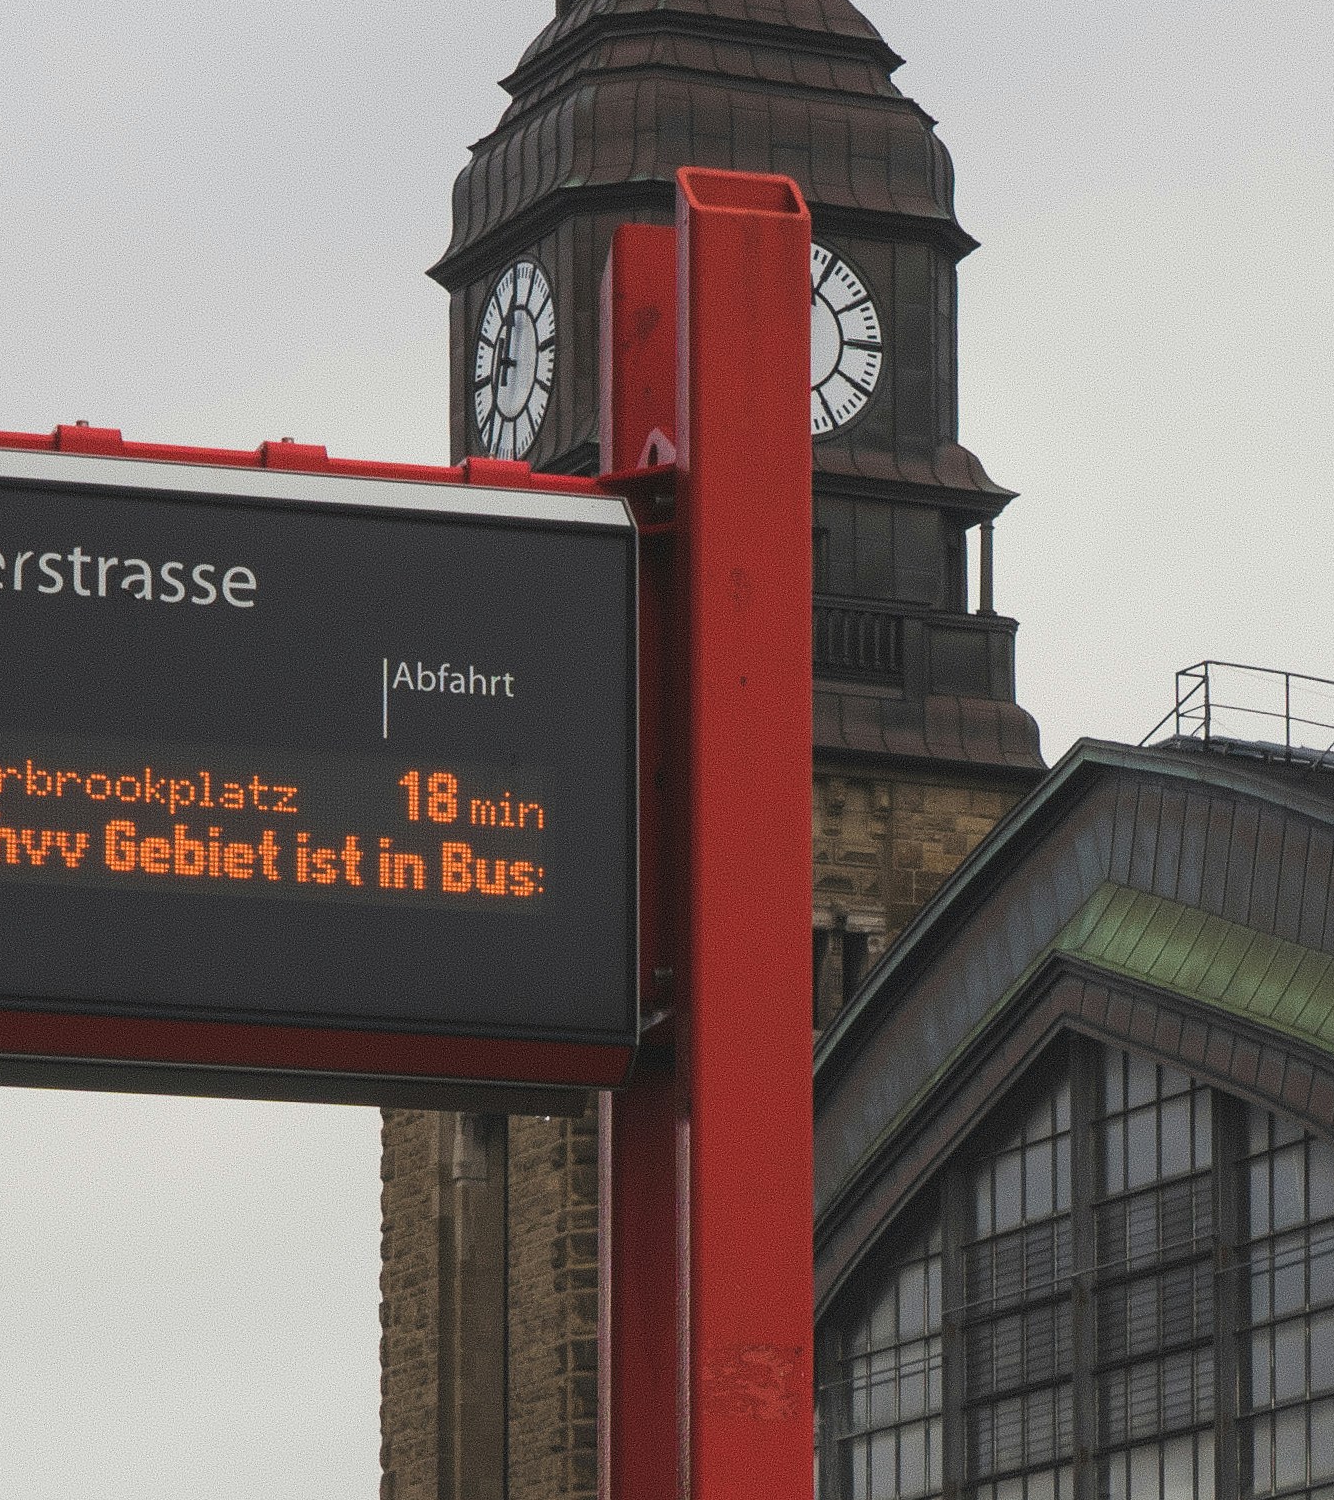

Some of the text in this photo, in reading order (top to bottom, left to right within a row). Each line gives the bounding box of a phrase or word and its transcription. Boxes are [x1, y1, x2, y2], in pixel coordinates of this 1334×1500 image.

[393, 660, 515, 699] Abfahrt
[398, 770, 459, 824] 18
[470, 791, 545, 831] min
[104, 819, 281, 882] Gebiet
[296, 831, 364, 887] ist
[378, 837, 427, 891] in
